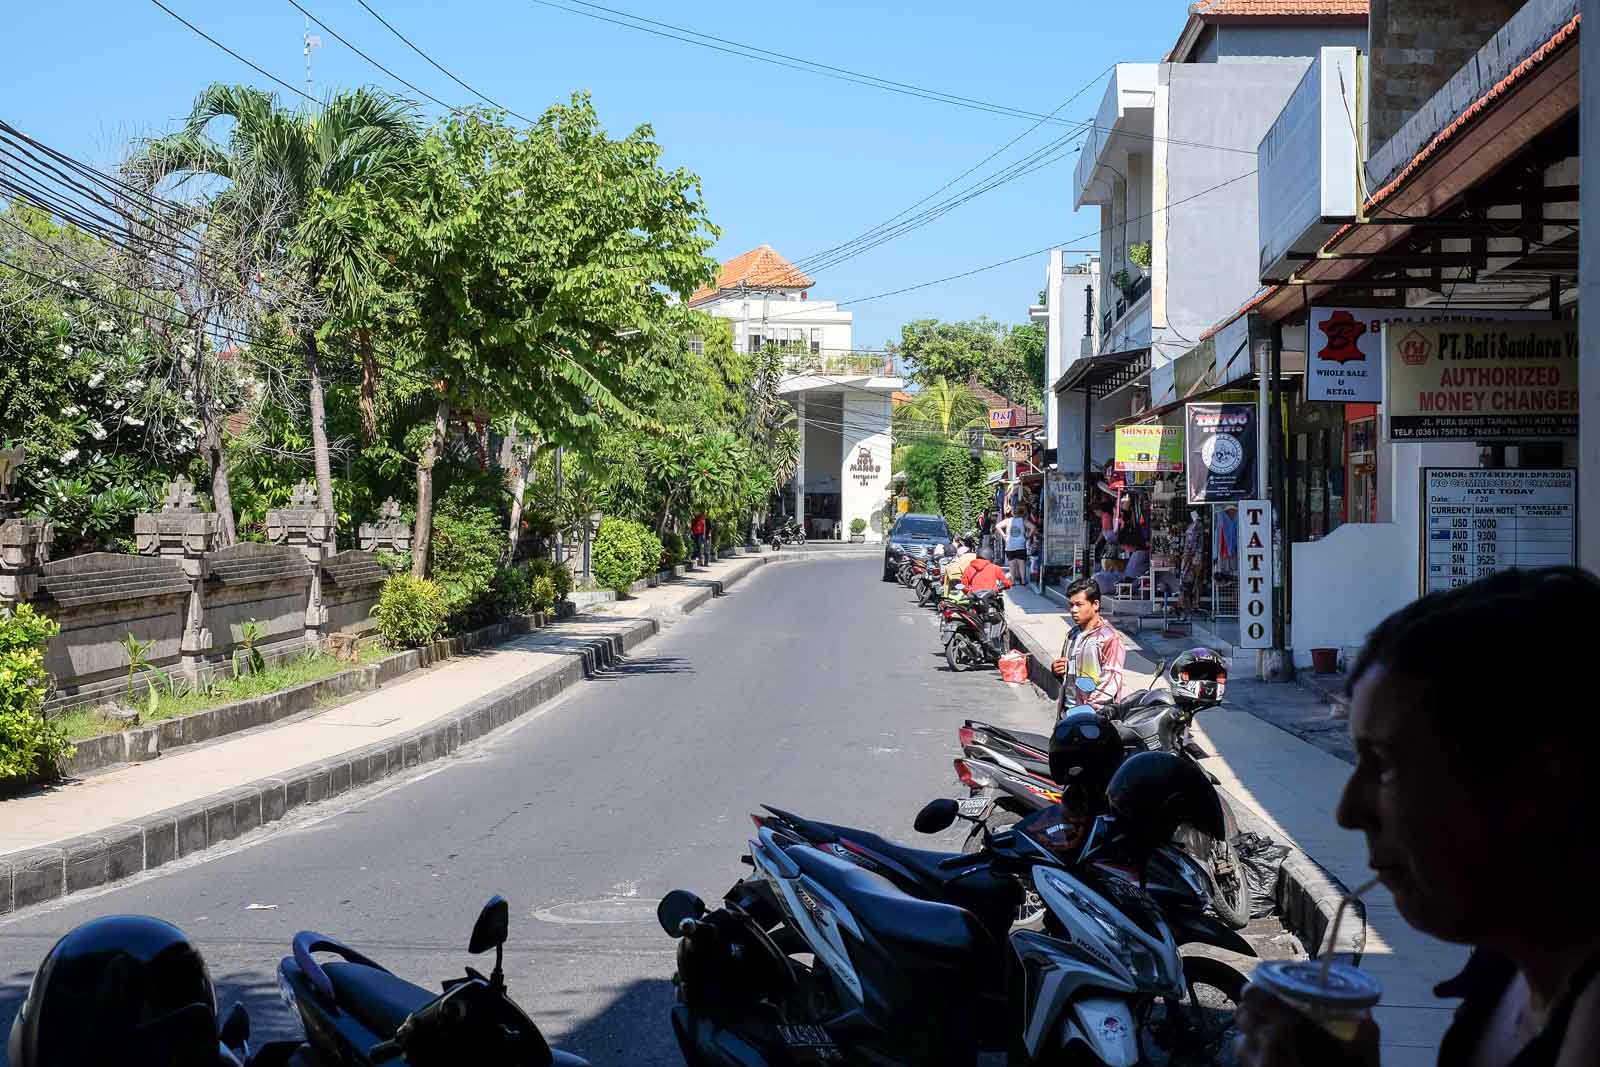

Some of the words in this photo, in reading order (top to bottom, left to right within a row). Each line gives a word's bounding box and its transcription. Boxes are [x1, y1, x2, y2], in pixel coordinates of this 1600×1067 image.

[1463, 332, 1496, 360] Bali
[1499, 332, 1562, 360] Saudara
[1316, 369, 1345, 377] WHOLE
[1440, 367, 1560, 387] AUTHORIZED
[1419, 391, 1486, 411] MONEY
[1431, 506, 1472, 514] CURRENCY
[1475, 506, 1494, 514] BANK
[1452, 518, 1468, 527] USD
[1452, 531, 1468, 540] AUD
[1452, 543, 1468, 552] HKD
[1452, 555, 1465, 564] SIN
[1246, 508, 1264, 641] TATTOO
[1452, 567, 1468, 576] MAL
